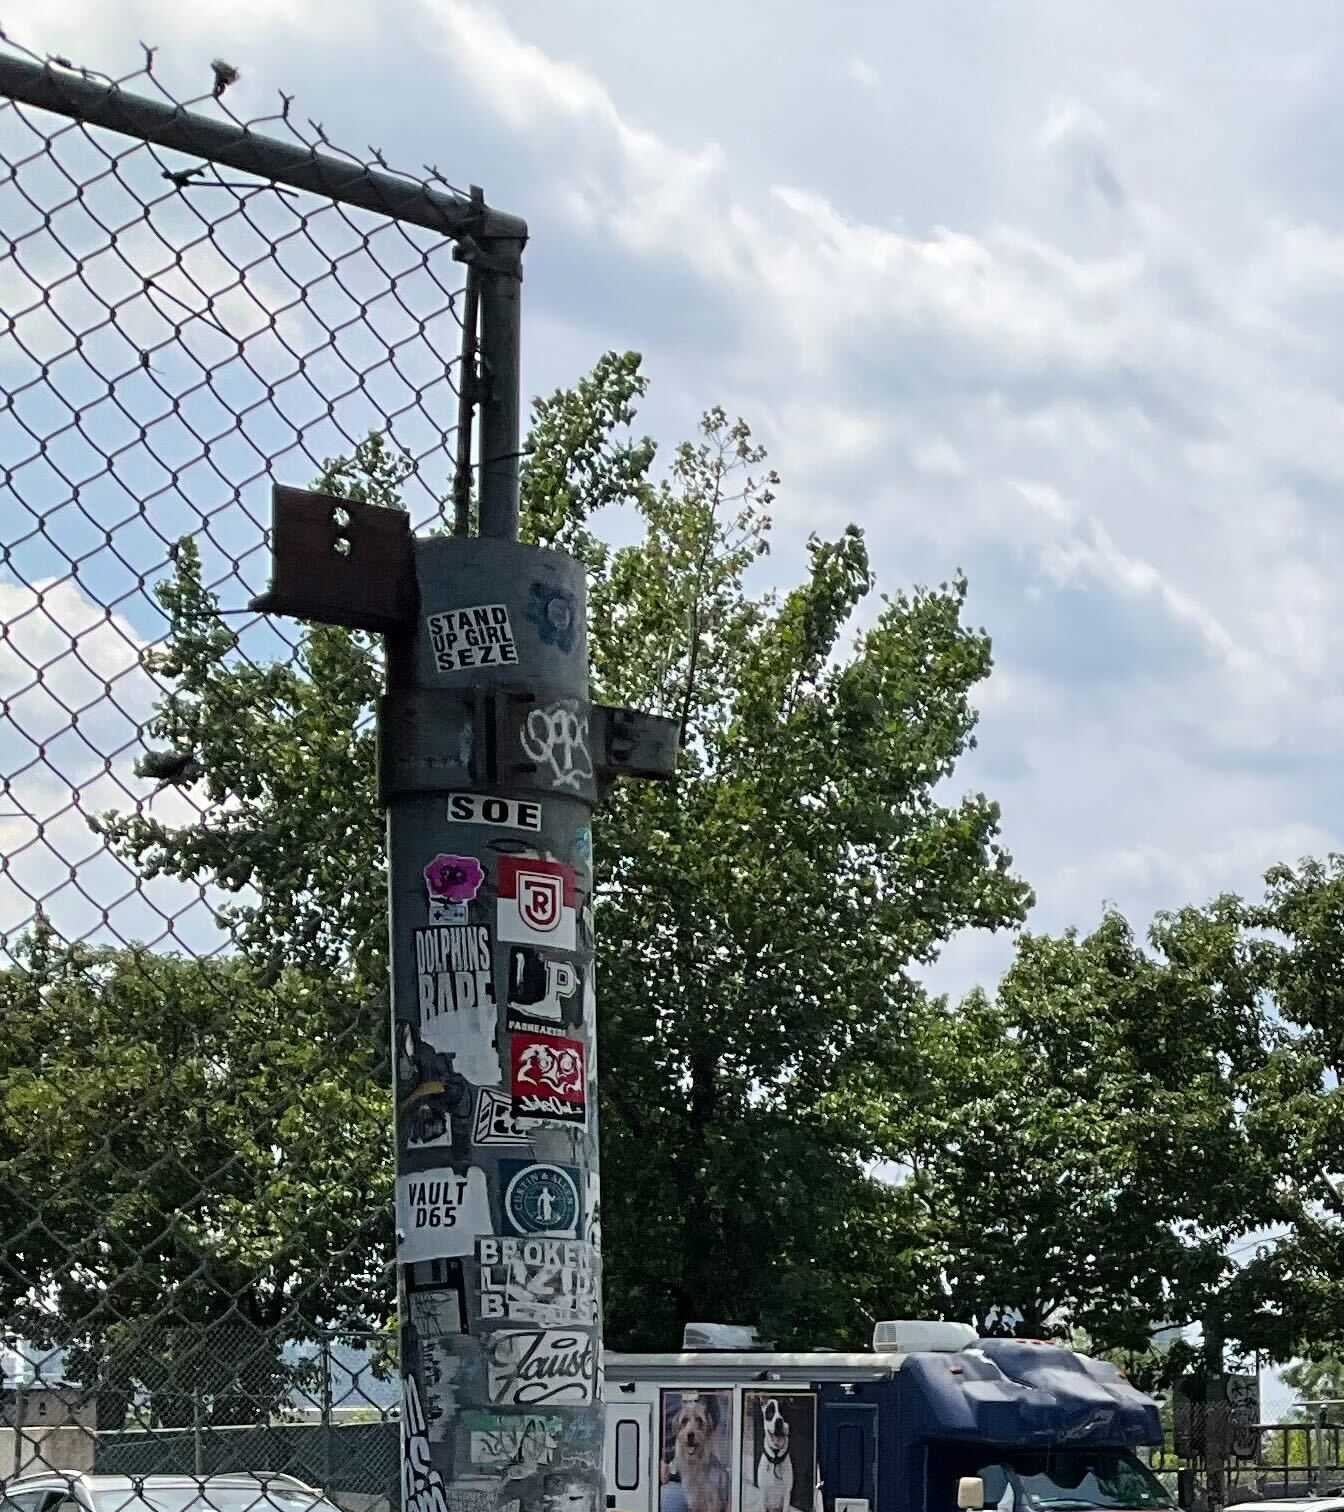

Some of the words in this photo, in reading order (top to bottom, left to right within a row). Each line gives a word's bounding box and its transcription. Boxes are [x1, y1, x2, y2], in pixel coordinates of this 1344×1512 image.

[430, 606, 508, 635] STAND
[432, 632, 458, 654] UP
[464, 626, 514, 646] GIRL
[437, 643, 518, 671] SEZE
[450, 796, 540, 828] SOE
[416, 926, 491, 974] DOLPHINS
[408, 1182, 468, 1206] VAULT
[415, 1206, 457, 1228] D65
[480, 1239, 592, 1270] BROKEN
